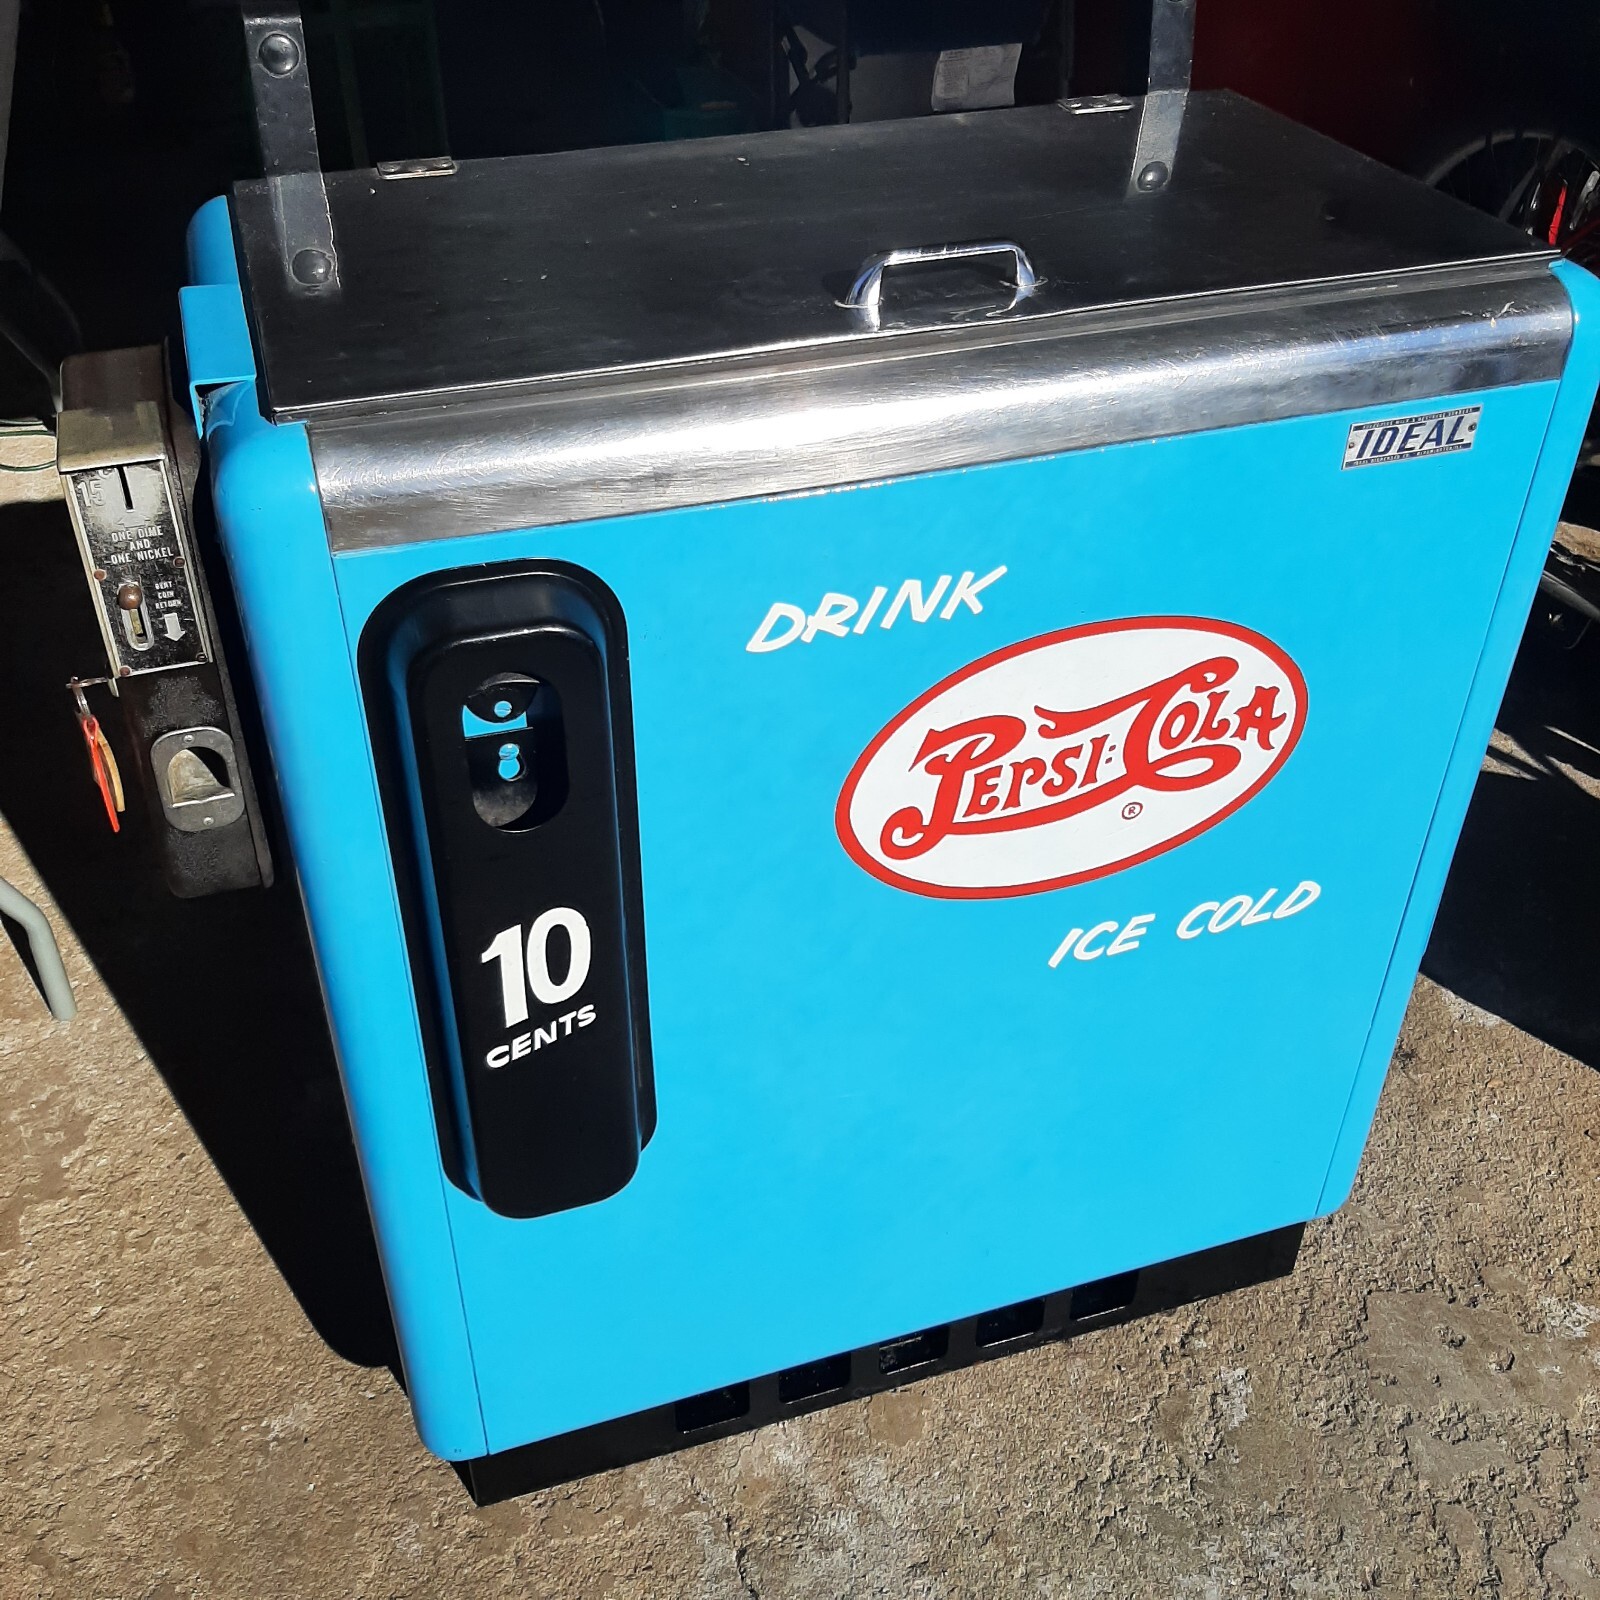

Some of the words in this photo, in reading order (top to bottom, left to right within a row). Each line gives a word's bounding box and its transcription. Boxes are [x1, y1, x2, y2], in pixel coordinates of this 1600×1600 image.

[1356, 415, 1465, 459] IDEAL
[110, 553, 132, 565] ONE
[138, 547, 174, 561] NICKEL
[111, 532, 132, 542] ONE
[138, 526, 164, 539] DIME
[130, 539, 150, 551] AND
[745, 565, 1008, 653] DRINK
[1047, 913, 1156, 969] ICE
[1176, 880, 1322, 940] COLD
[481, 907, 592, 1029] 10
[486, 1004, 597, 1069] CENTS
